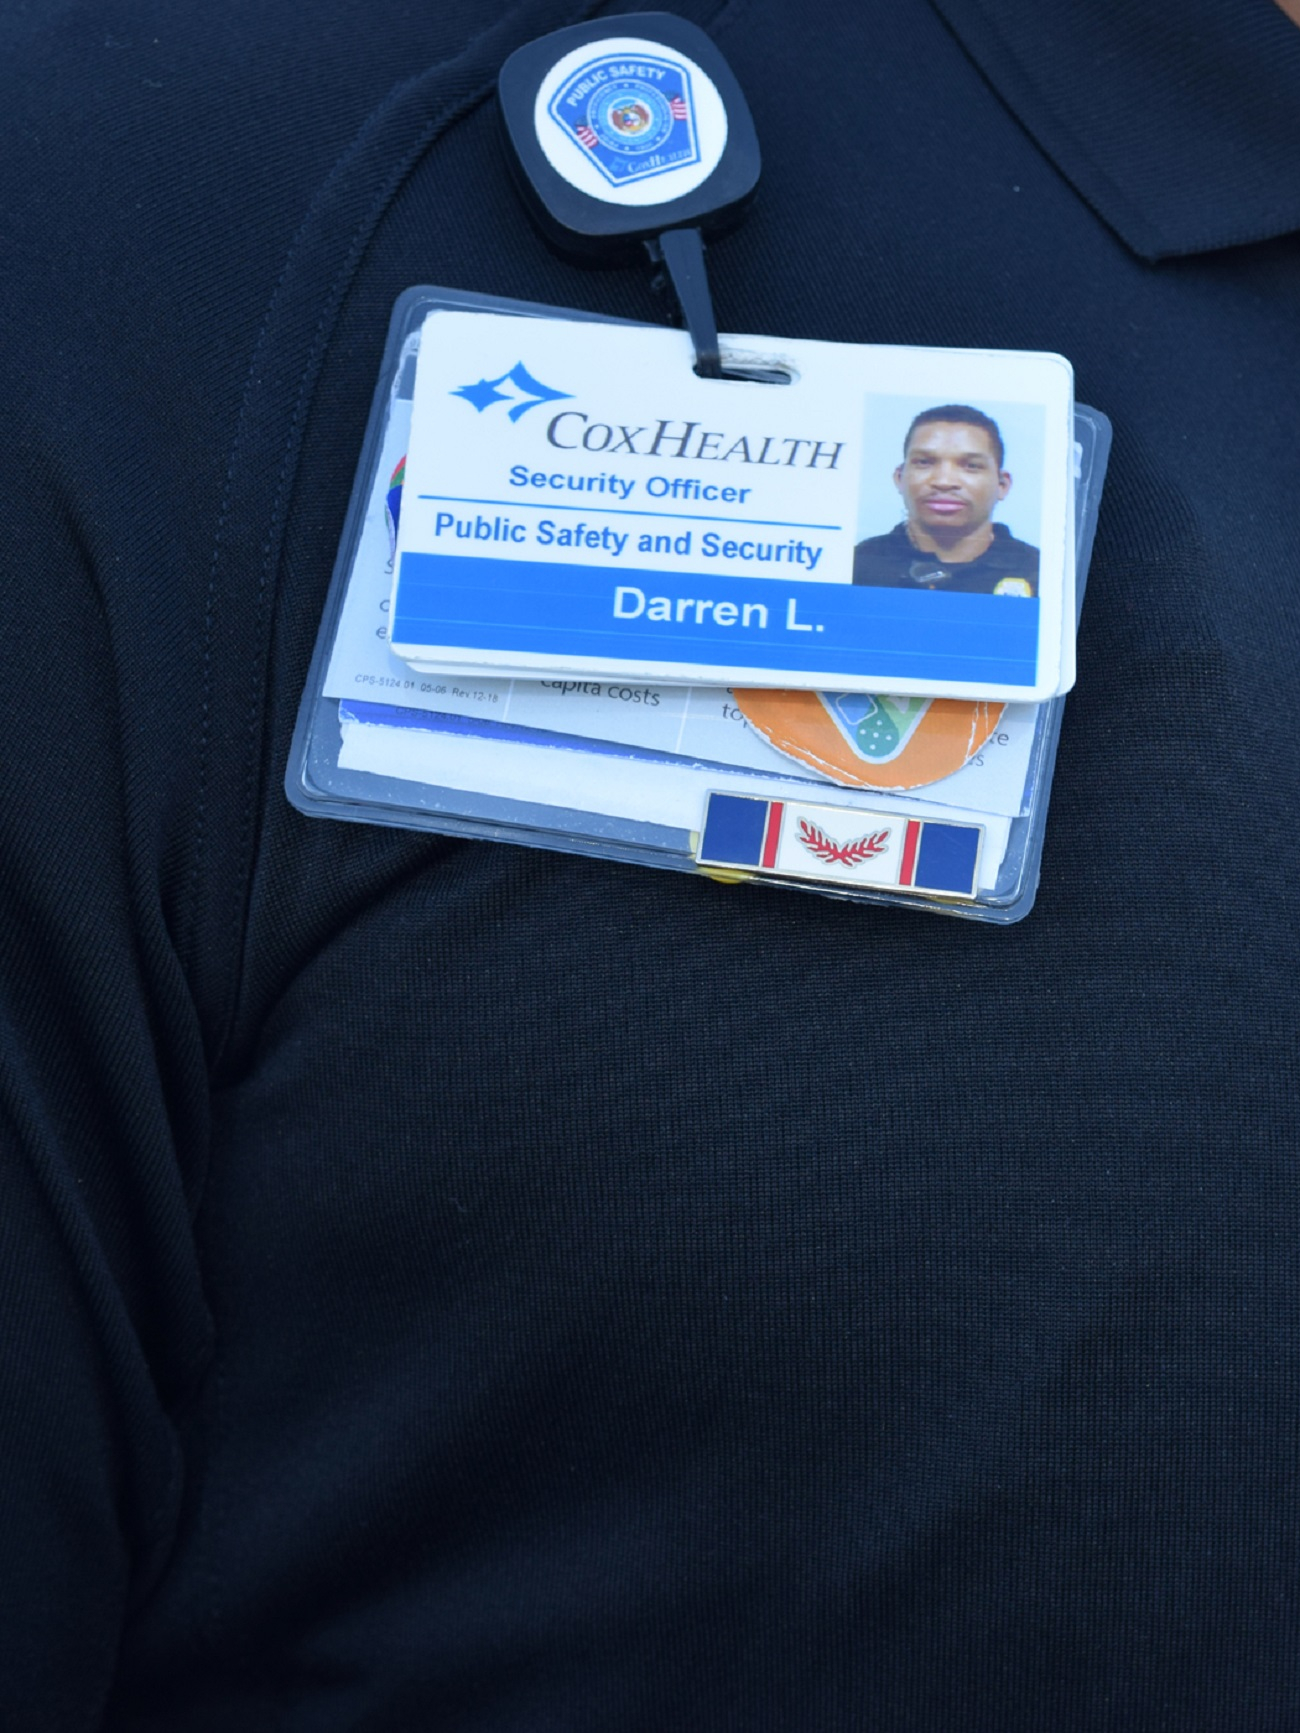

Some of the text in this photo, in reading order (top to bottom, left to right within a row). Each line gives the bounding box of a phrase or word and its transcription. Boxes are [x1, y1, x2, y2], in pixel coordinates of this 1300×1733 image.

[566, 64, 666, 107] PUBLIC SAFETY
[509, 465, 752, 504] Security Officer
[434, 511, 823, 571] Public Safety and Security
[612, 585, 825, 632] Darren L.
[607, 685, 661, 707] costs
